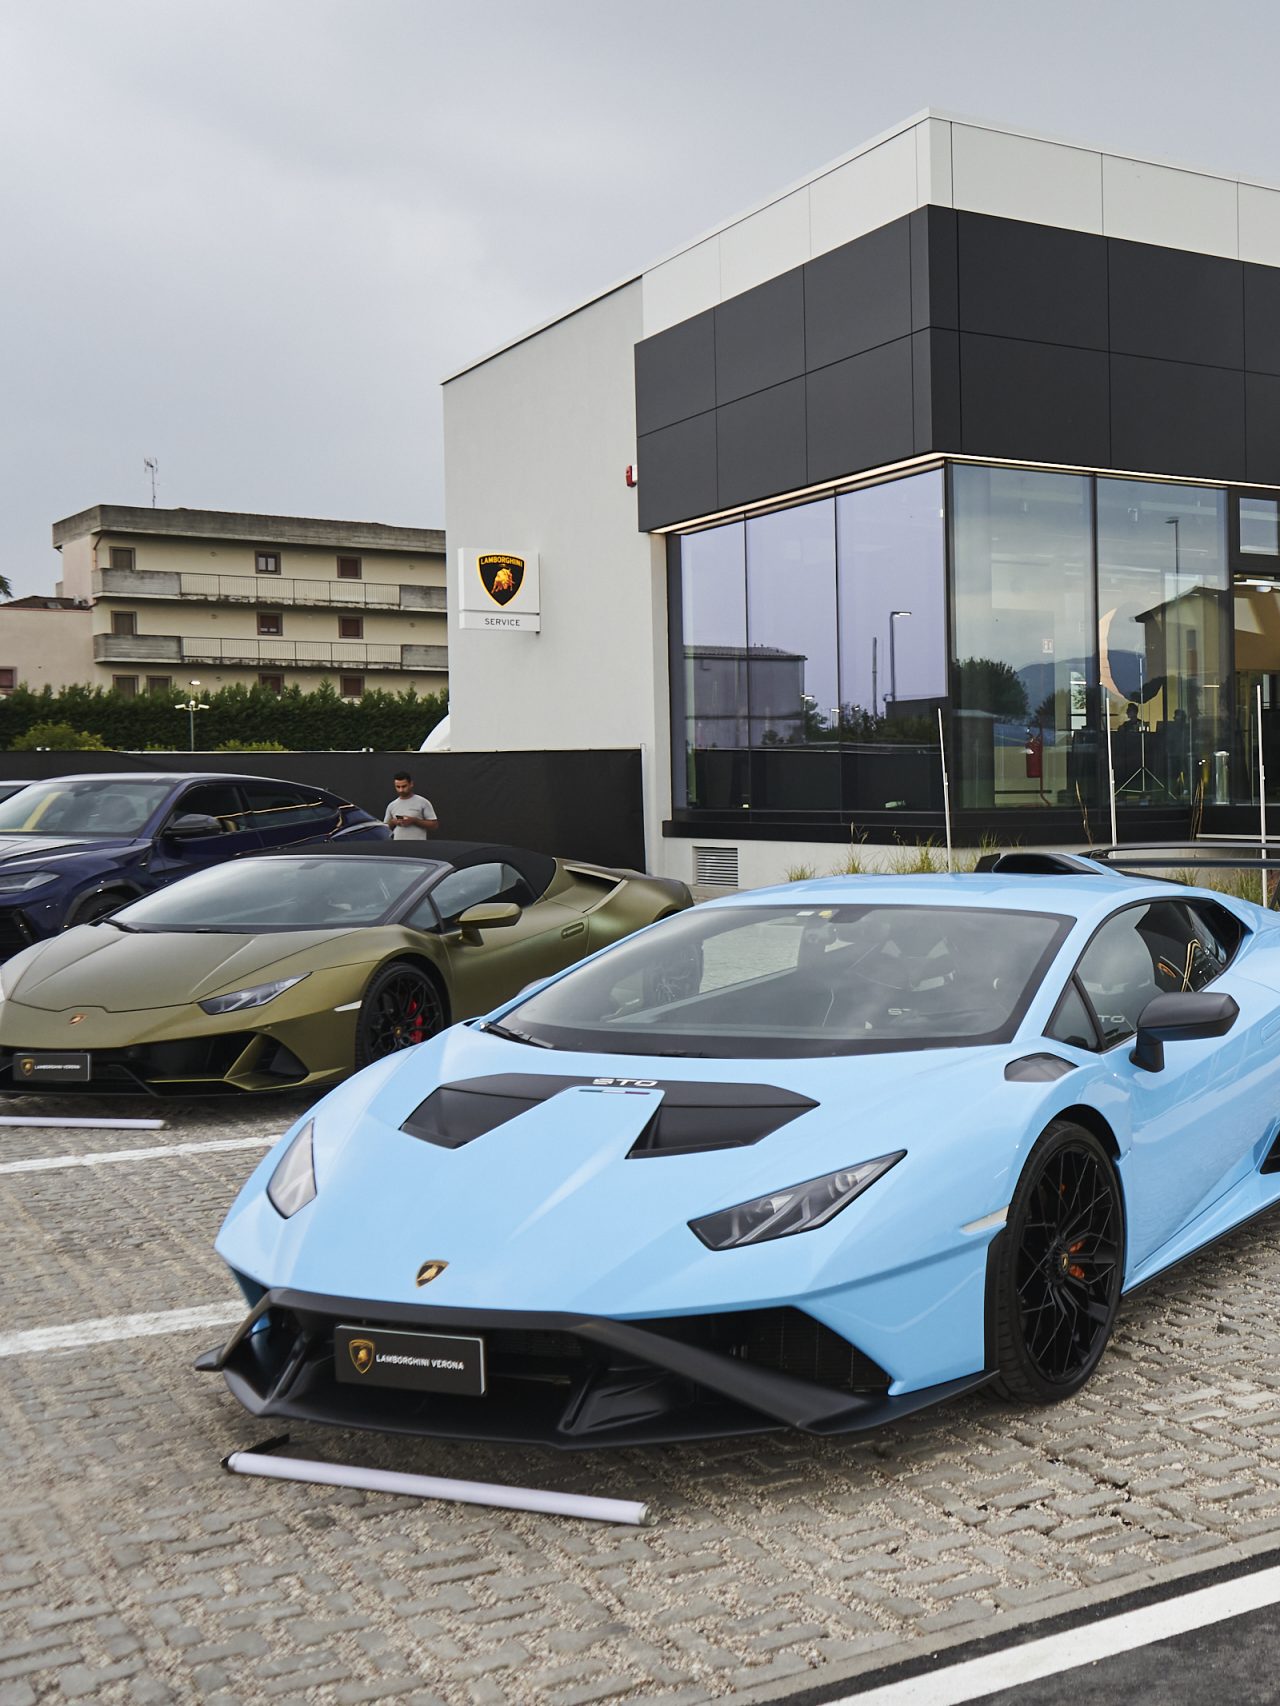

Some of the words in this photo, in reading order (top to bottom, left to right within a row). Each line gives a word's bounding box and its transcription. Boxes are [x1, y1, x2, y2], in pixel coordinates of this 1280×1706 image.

[480, 556, 523, 567] LAMBORGHINI
[484, 617, 521, 627] SERVICE
[592, 1078, 658, 1087] STO
[375, 1354, 430, 1367] LAMBORGHINI
[431, 1359, 464, 1370] VERONA
